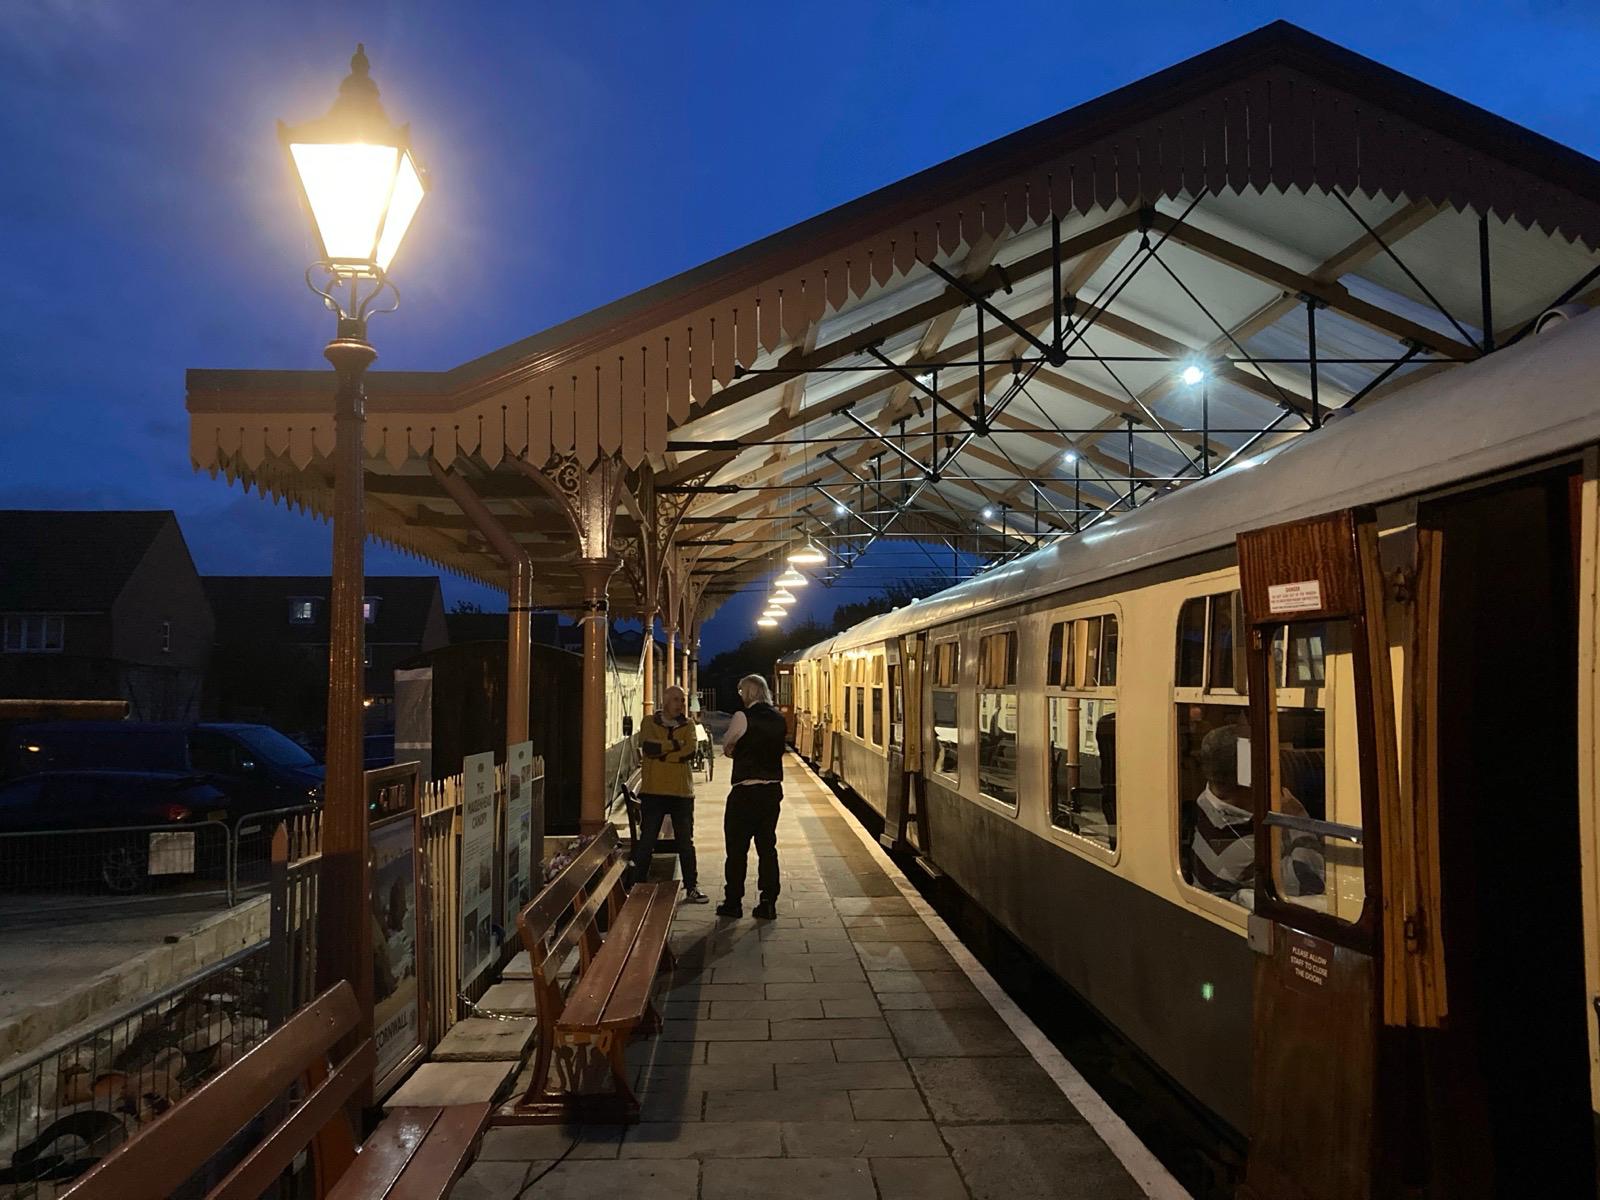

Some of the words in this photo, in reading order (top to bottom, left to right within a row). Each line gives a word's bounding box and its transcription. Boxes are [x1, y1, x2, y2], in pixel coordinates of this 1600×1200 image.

[1292, 946, 1309, 958] PLEASE
[1309, 953, 1328, 965] ALLOW
[1290, 955, 1304, 967] STAFF
[1305, 961, 1312, 971] TO
[1313, 964, 1328, 978] CLOSE
[1295, 967, 1304, 978] THE
